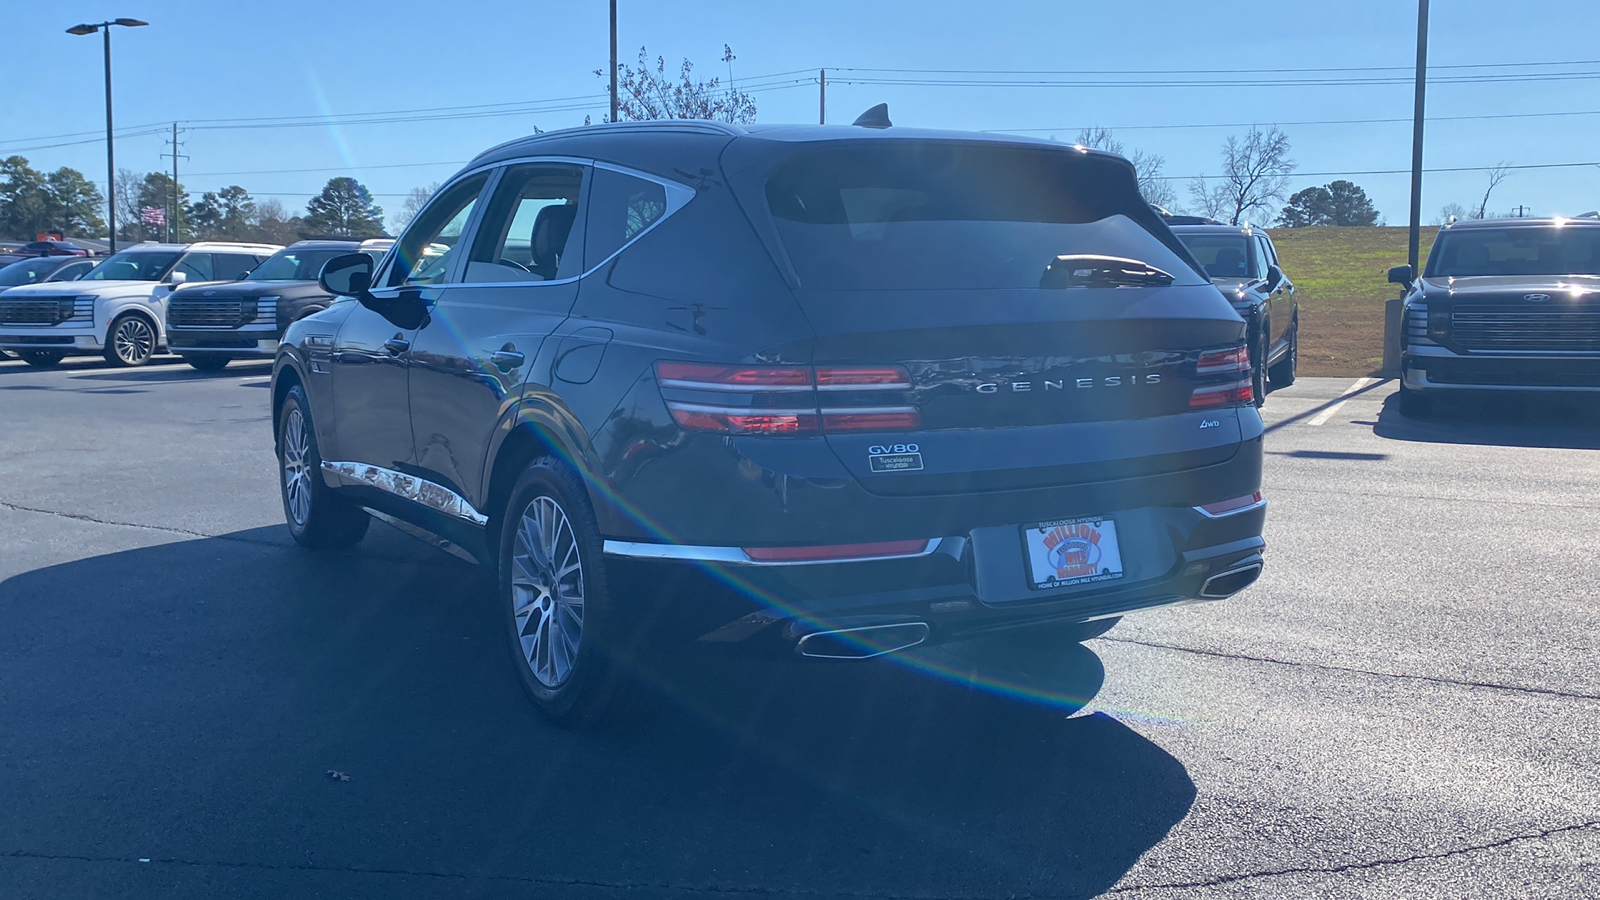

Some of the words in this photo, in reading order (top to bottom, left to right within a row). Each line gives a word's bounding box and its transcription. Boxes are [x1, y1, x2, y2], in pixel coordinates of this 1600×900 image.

[976, 374, 1161, 394] GENESIS
[868, 443, 920, 454] GV80
[1038, 519, 1076, 527] TUSCALOOSA
[1042, 523, 1102, 552] MILLION
[1038, 581, 1053, 589] HOME
